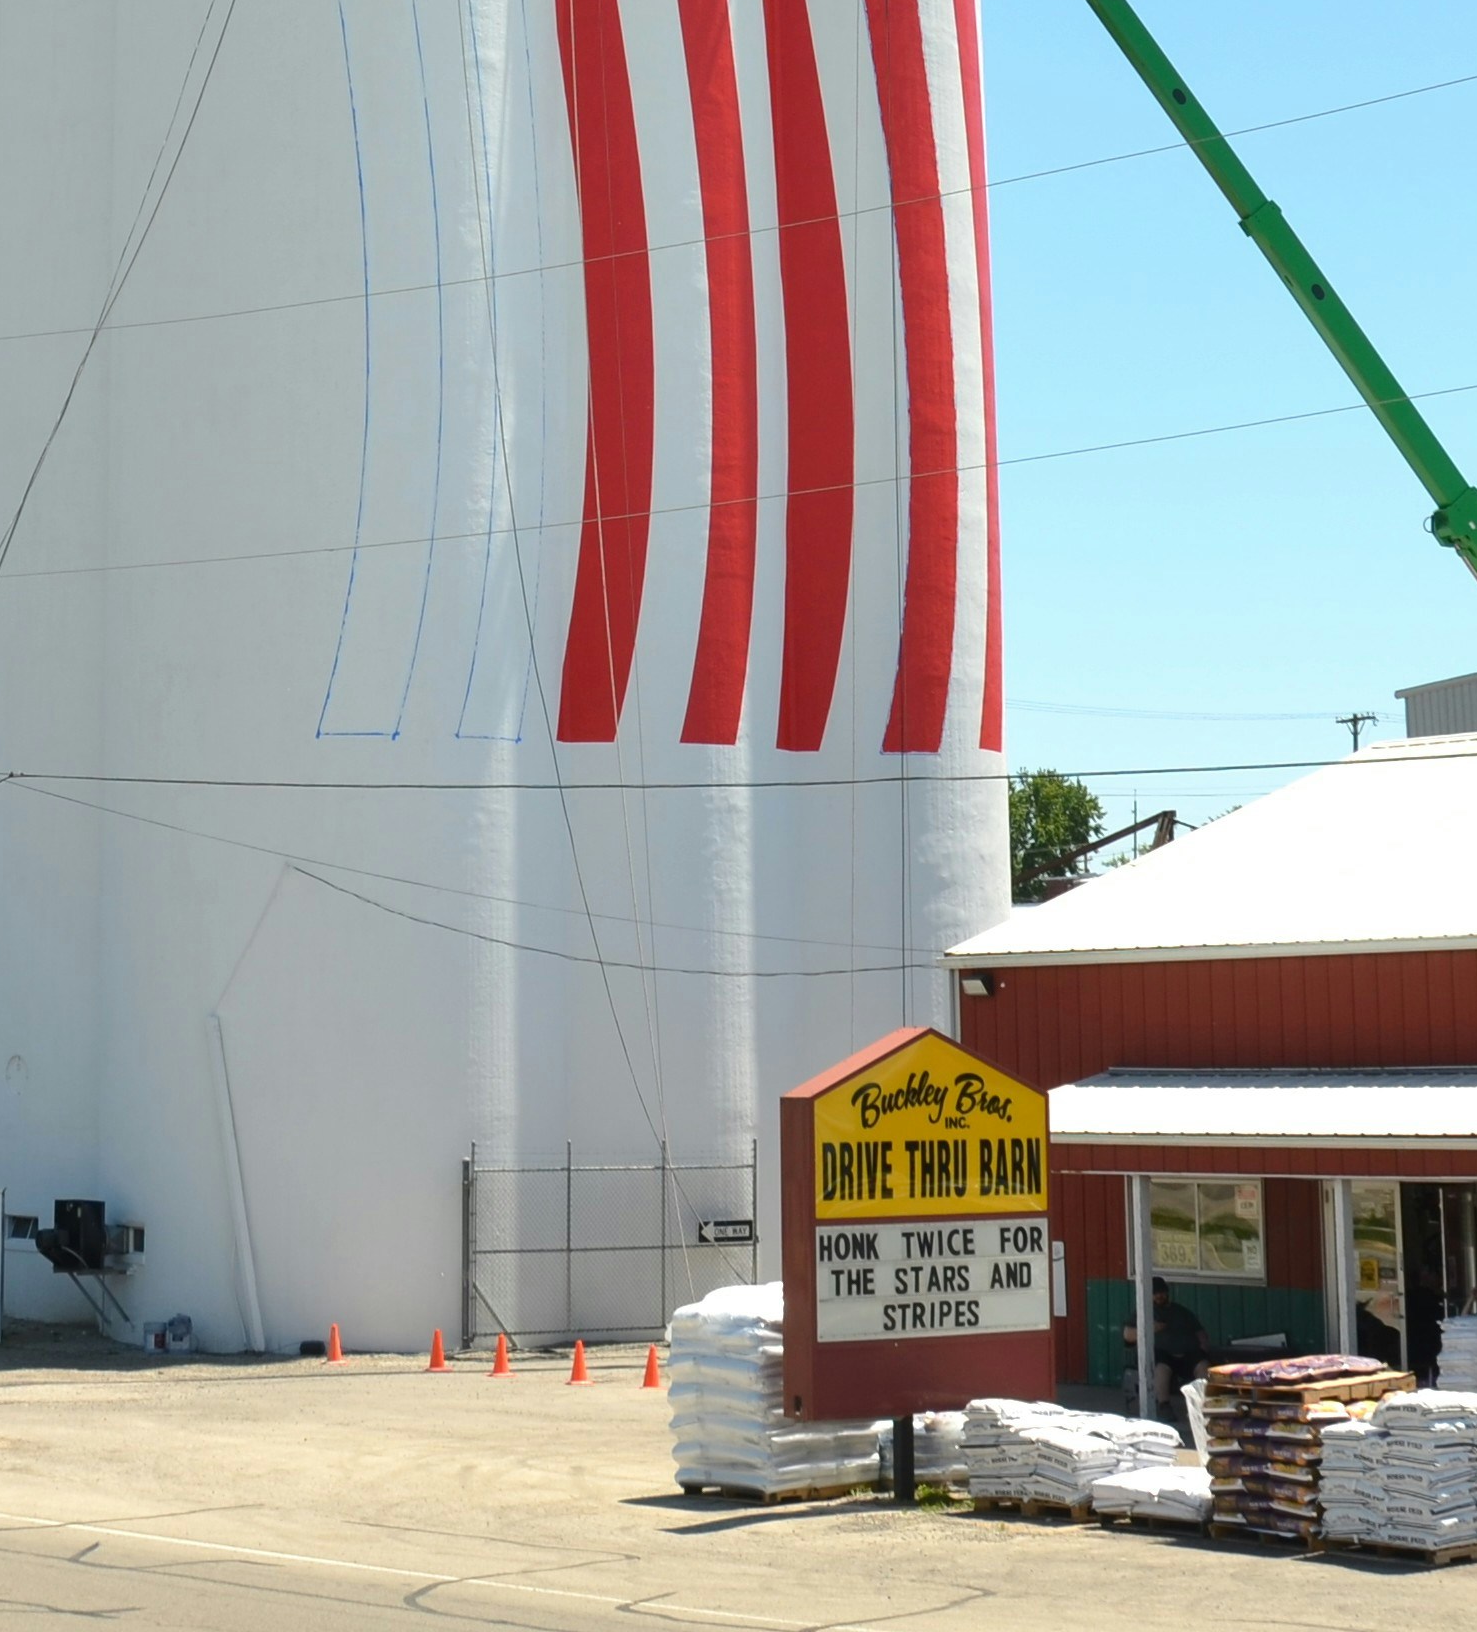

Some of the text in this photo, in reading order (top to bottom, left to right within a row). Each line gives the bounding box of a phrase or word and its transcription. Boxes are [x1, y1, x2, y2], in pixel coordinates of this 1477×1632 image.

[851, 1071, 1013, 1129] Buckley Bros.
[945, 1116, 970, 1129] INC.
[822, 1137, 1041, 1201] DRIVE THRU BARN
[714, 1227, 748, 1236] ONE WAY
[819, 1226, 1044, 1262] HONK TWICE FOR
[831, 1261, 1032, 1296] THE STARS AND
[883, 1300, 980, 1331] STRIPES
